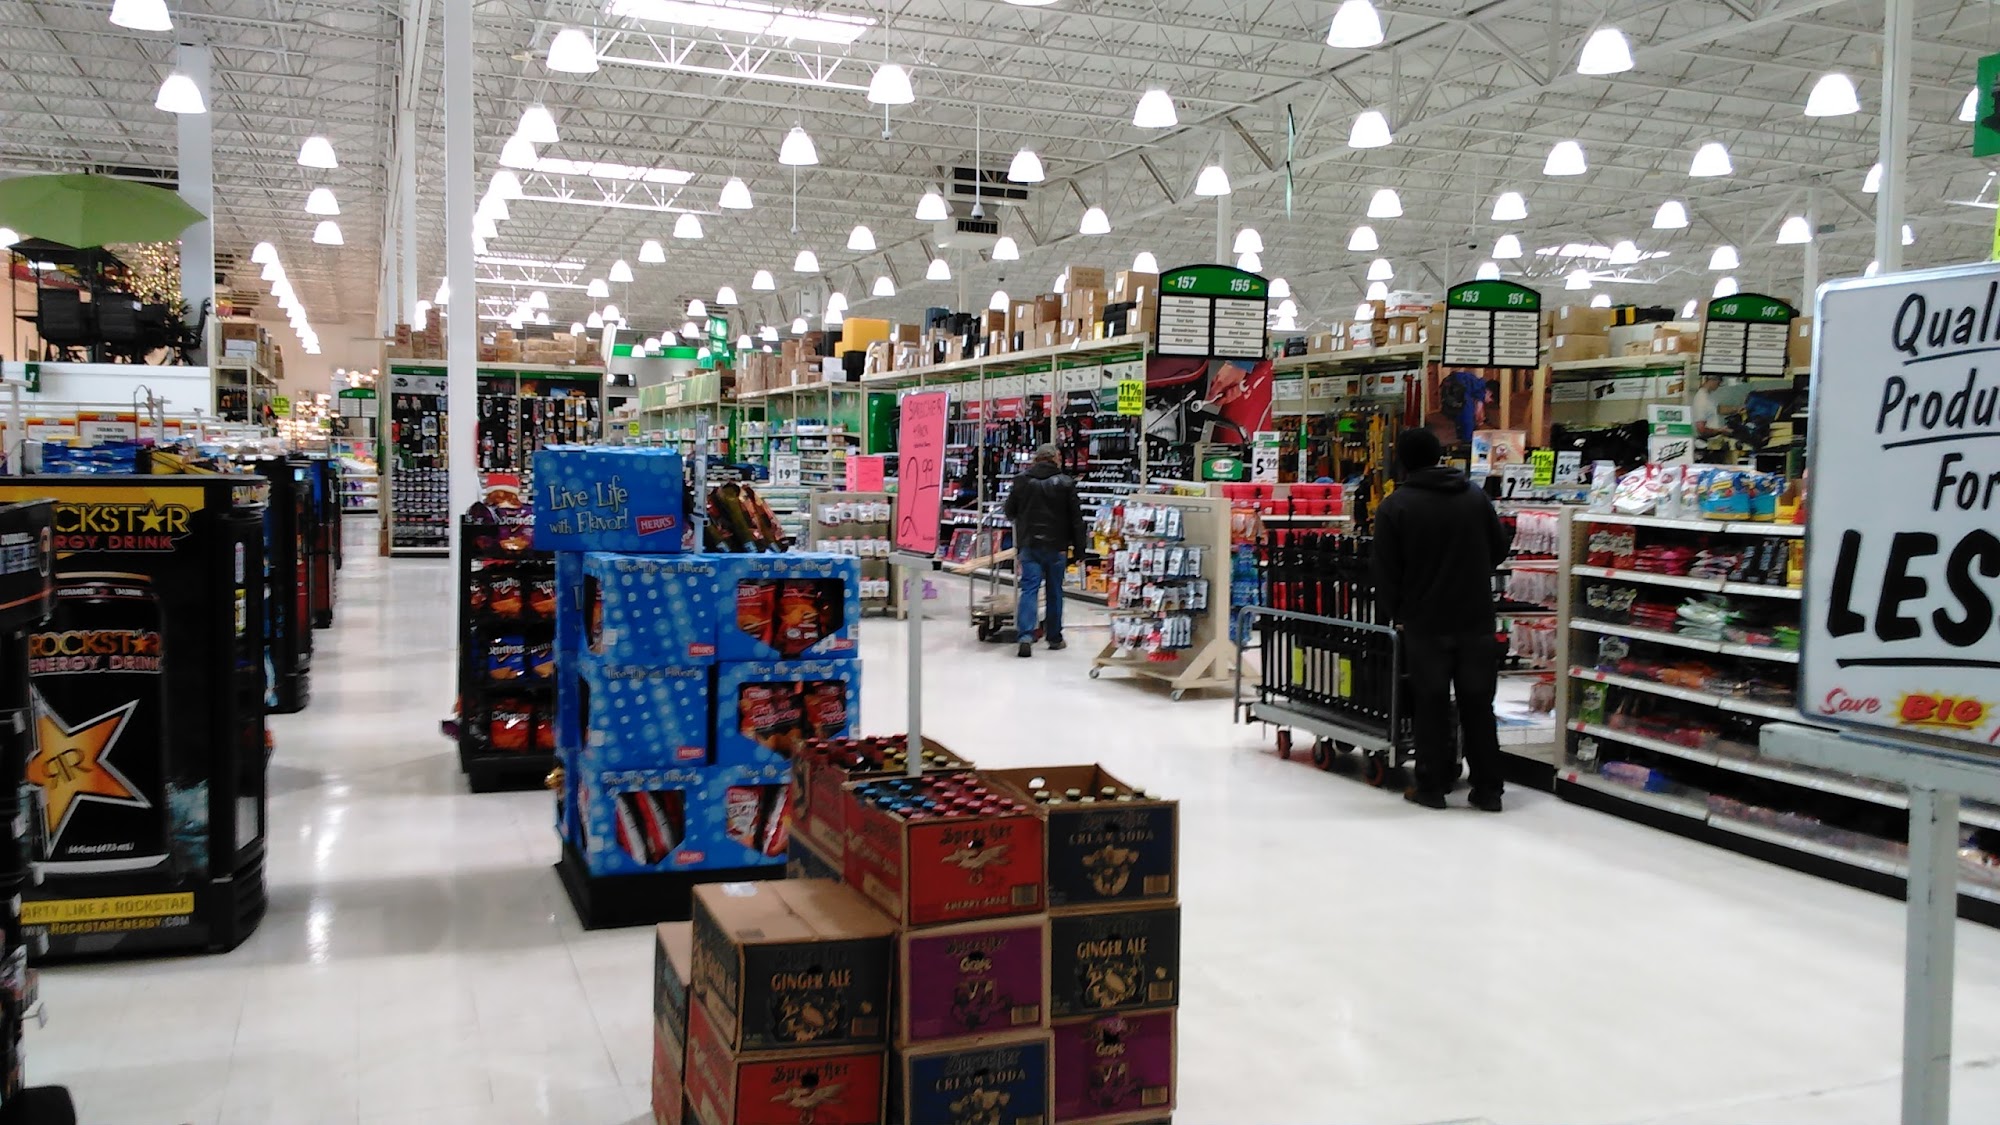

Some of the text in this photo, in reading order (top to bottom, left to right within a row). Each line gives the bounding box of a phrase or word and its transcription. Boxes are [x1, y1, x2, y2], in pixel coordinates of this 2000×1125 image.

[1177, 276, 1197, 289] 157
[1230, 279, 1250, 292] 155
[1462, 290, 1480, 303] 153
[1508, 293, 1524, 304] 151
[1721, 303, 1738, 315] 149
[1761, 305, 1779, 317] 147
[1120, 383, 1142, 395] 11%
[1875, 368, 2000, 434] Produ
[548, 475, 628, 513] Live Life
[56, 505, 188, 533] CKSTAR
[549, 508, 628, 534] with Flavor!
[55, 535, 173, 549] RGY DRINK
[1827, 527, 2000, 646] LES
[1819, 688, 1882, 715] Save
[22, 897, 189, 919] ARTY LIKE A ROCKSTAR
[1077, 936, 1148, 959] GINGER ALE
[770, 968, 852, 991] GINGER ALE
